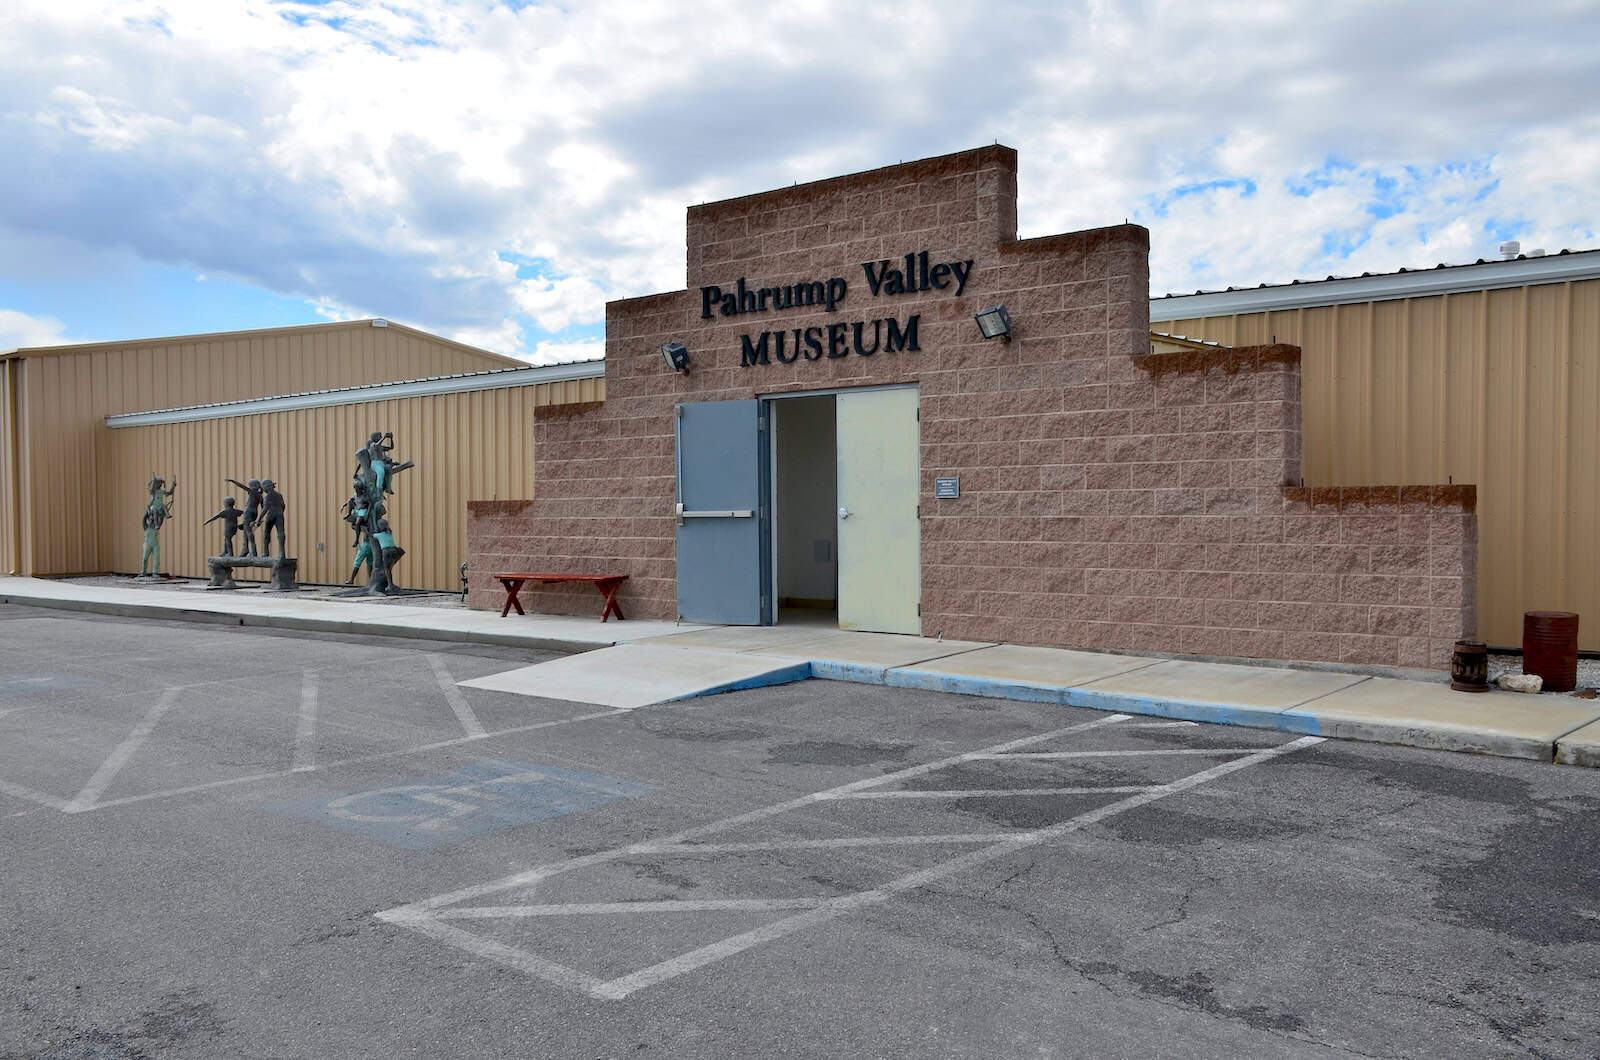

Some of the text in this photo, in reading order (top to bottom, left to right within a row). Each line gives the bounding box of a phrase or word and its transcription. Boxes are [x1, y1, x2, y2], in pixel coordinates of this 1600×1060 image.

[701, 250, 974, 318] Pahrump Valley
[740, 314, 921, 367] MUSEUM
